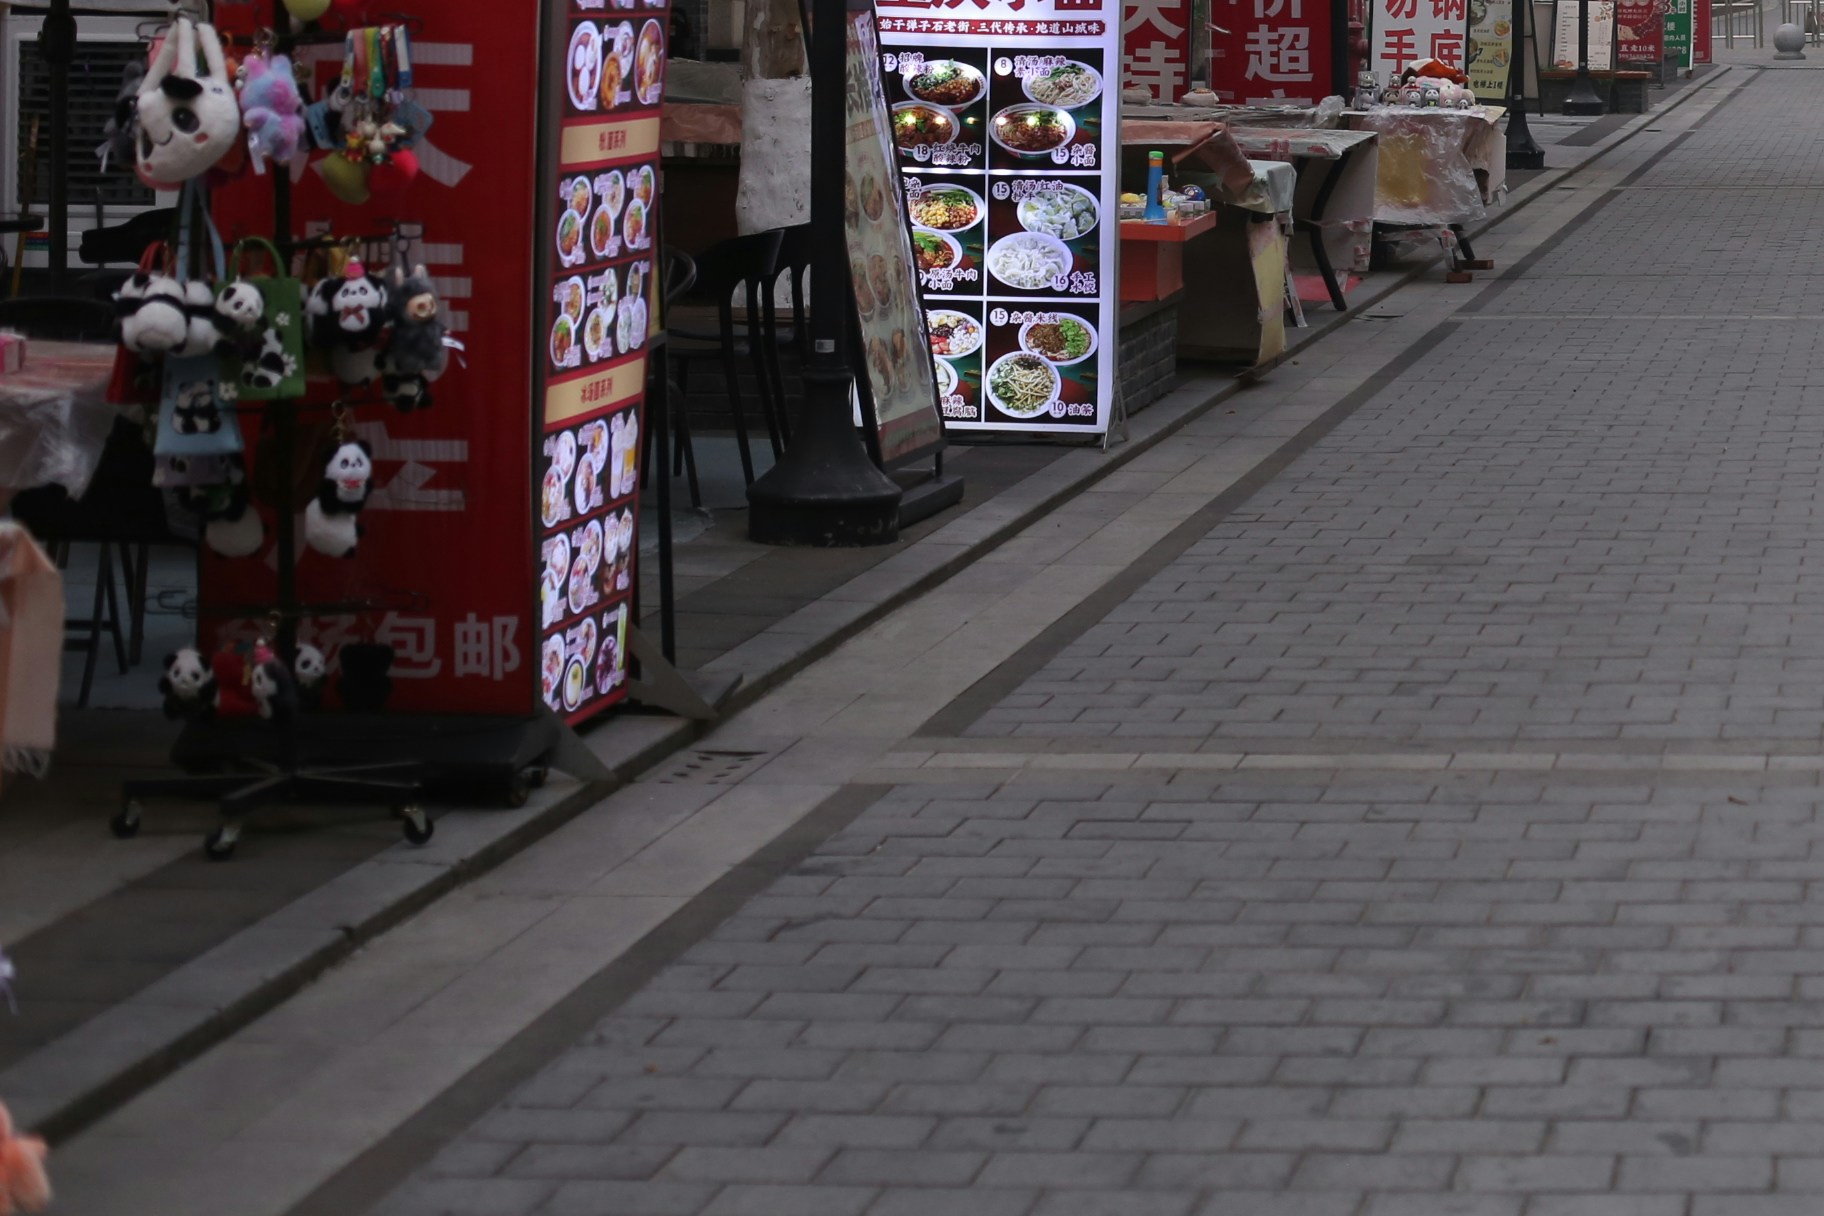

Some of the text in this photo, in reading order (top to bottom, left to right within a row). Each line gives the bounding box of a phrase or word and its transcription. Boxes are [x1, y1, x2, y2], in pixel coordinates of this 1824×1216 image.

[899, 52, 925, 63] 招牌
[899, 63, 935, 74] 酸辣粉
[1000, 59, 1007, 69] 8
[916, 143, 982, 155] 18 红烧牛肉
[1054, 148, 1066, 158] 15
[932, 154, 972, 165] 酸辣粉
[1071, 156, 1096, 167] 小面
[996, 180, 1064, 194] 15 清汤/红油
[1011, 191, 1036, 202] 抄手
[928, 269, 979, 280] 原汤牛肉
[1054, 272, 1095, 285] 16 手工
[928, 280, 953, 291] 小面
[1070, 283, 1097, 294] 水饺
[993, 310, 1006, 320] 15
[1052, 402, 1094, 416] 10 油茶
